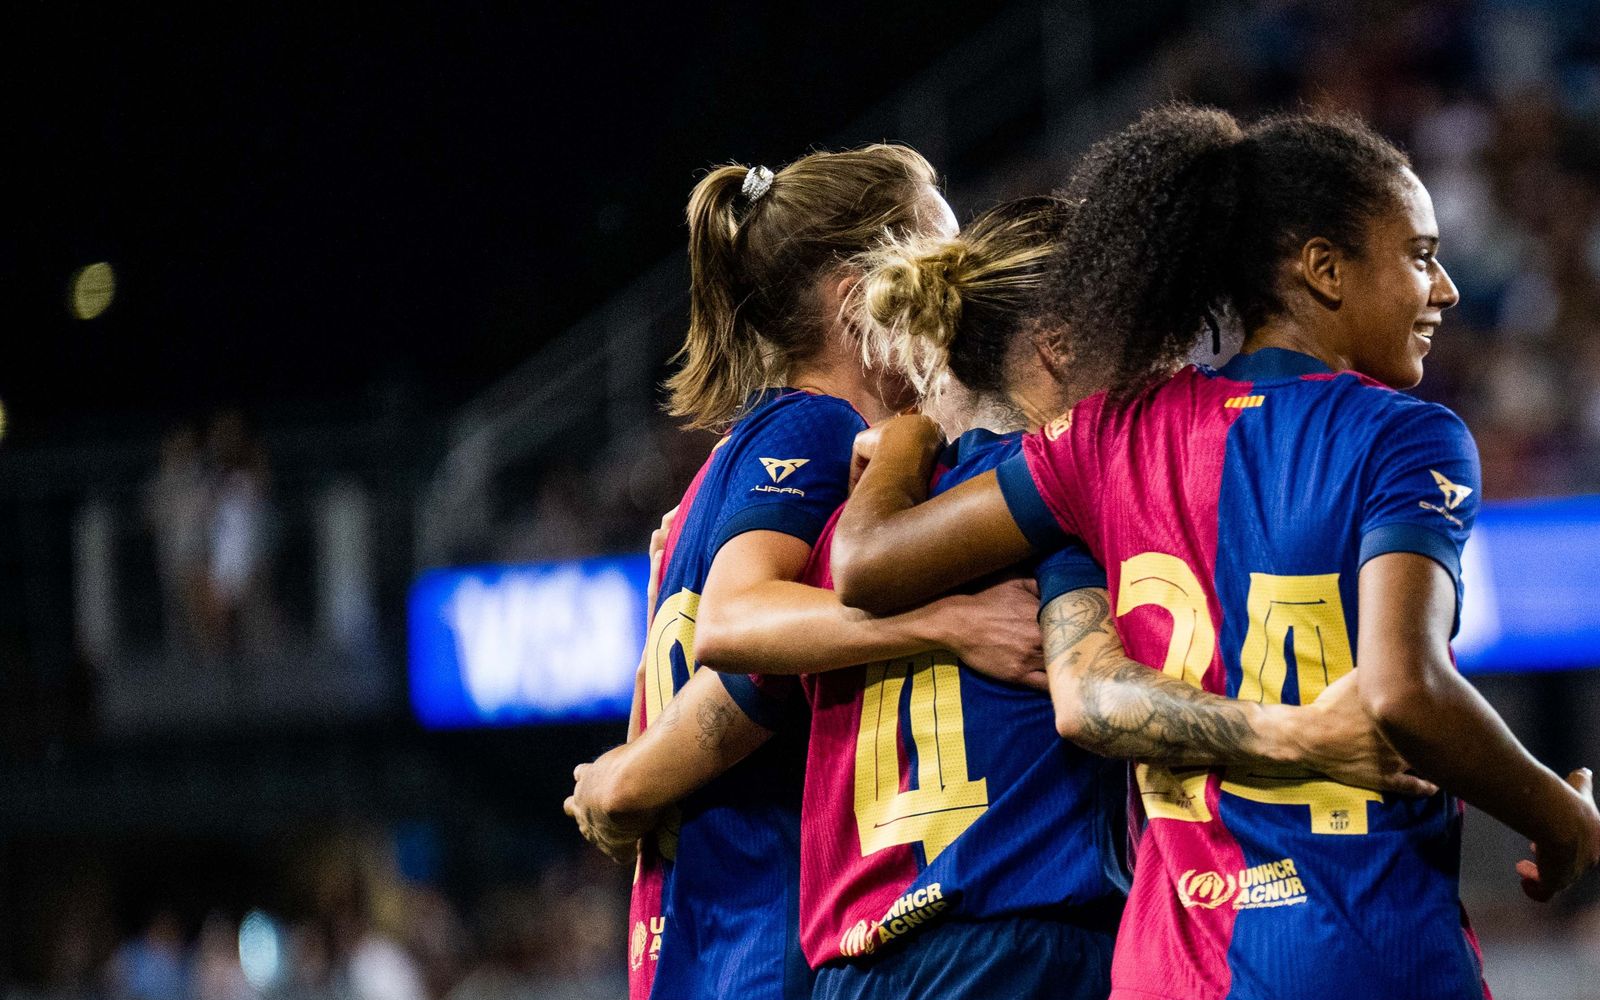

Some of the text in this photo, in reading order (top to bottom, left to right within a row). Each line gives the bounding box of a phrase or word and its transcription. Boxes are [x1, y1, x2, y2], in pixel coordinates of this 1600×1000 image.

[750, 485, 805, 497] UPRA
[1118, 552, 1383, 834] 24
[855, 645, 989, 868] 4
[1233, 876, 1307, 906] ACNUR
[1239, 858, 1298, 888] UNHCR
[878, 883, 943, 926] NHCR
